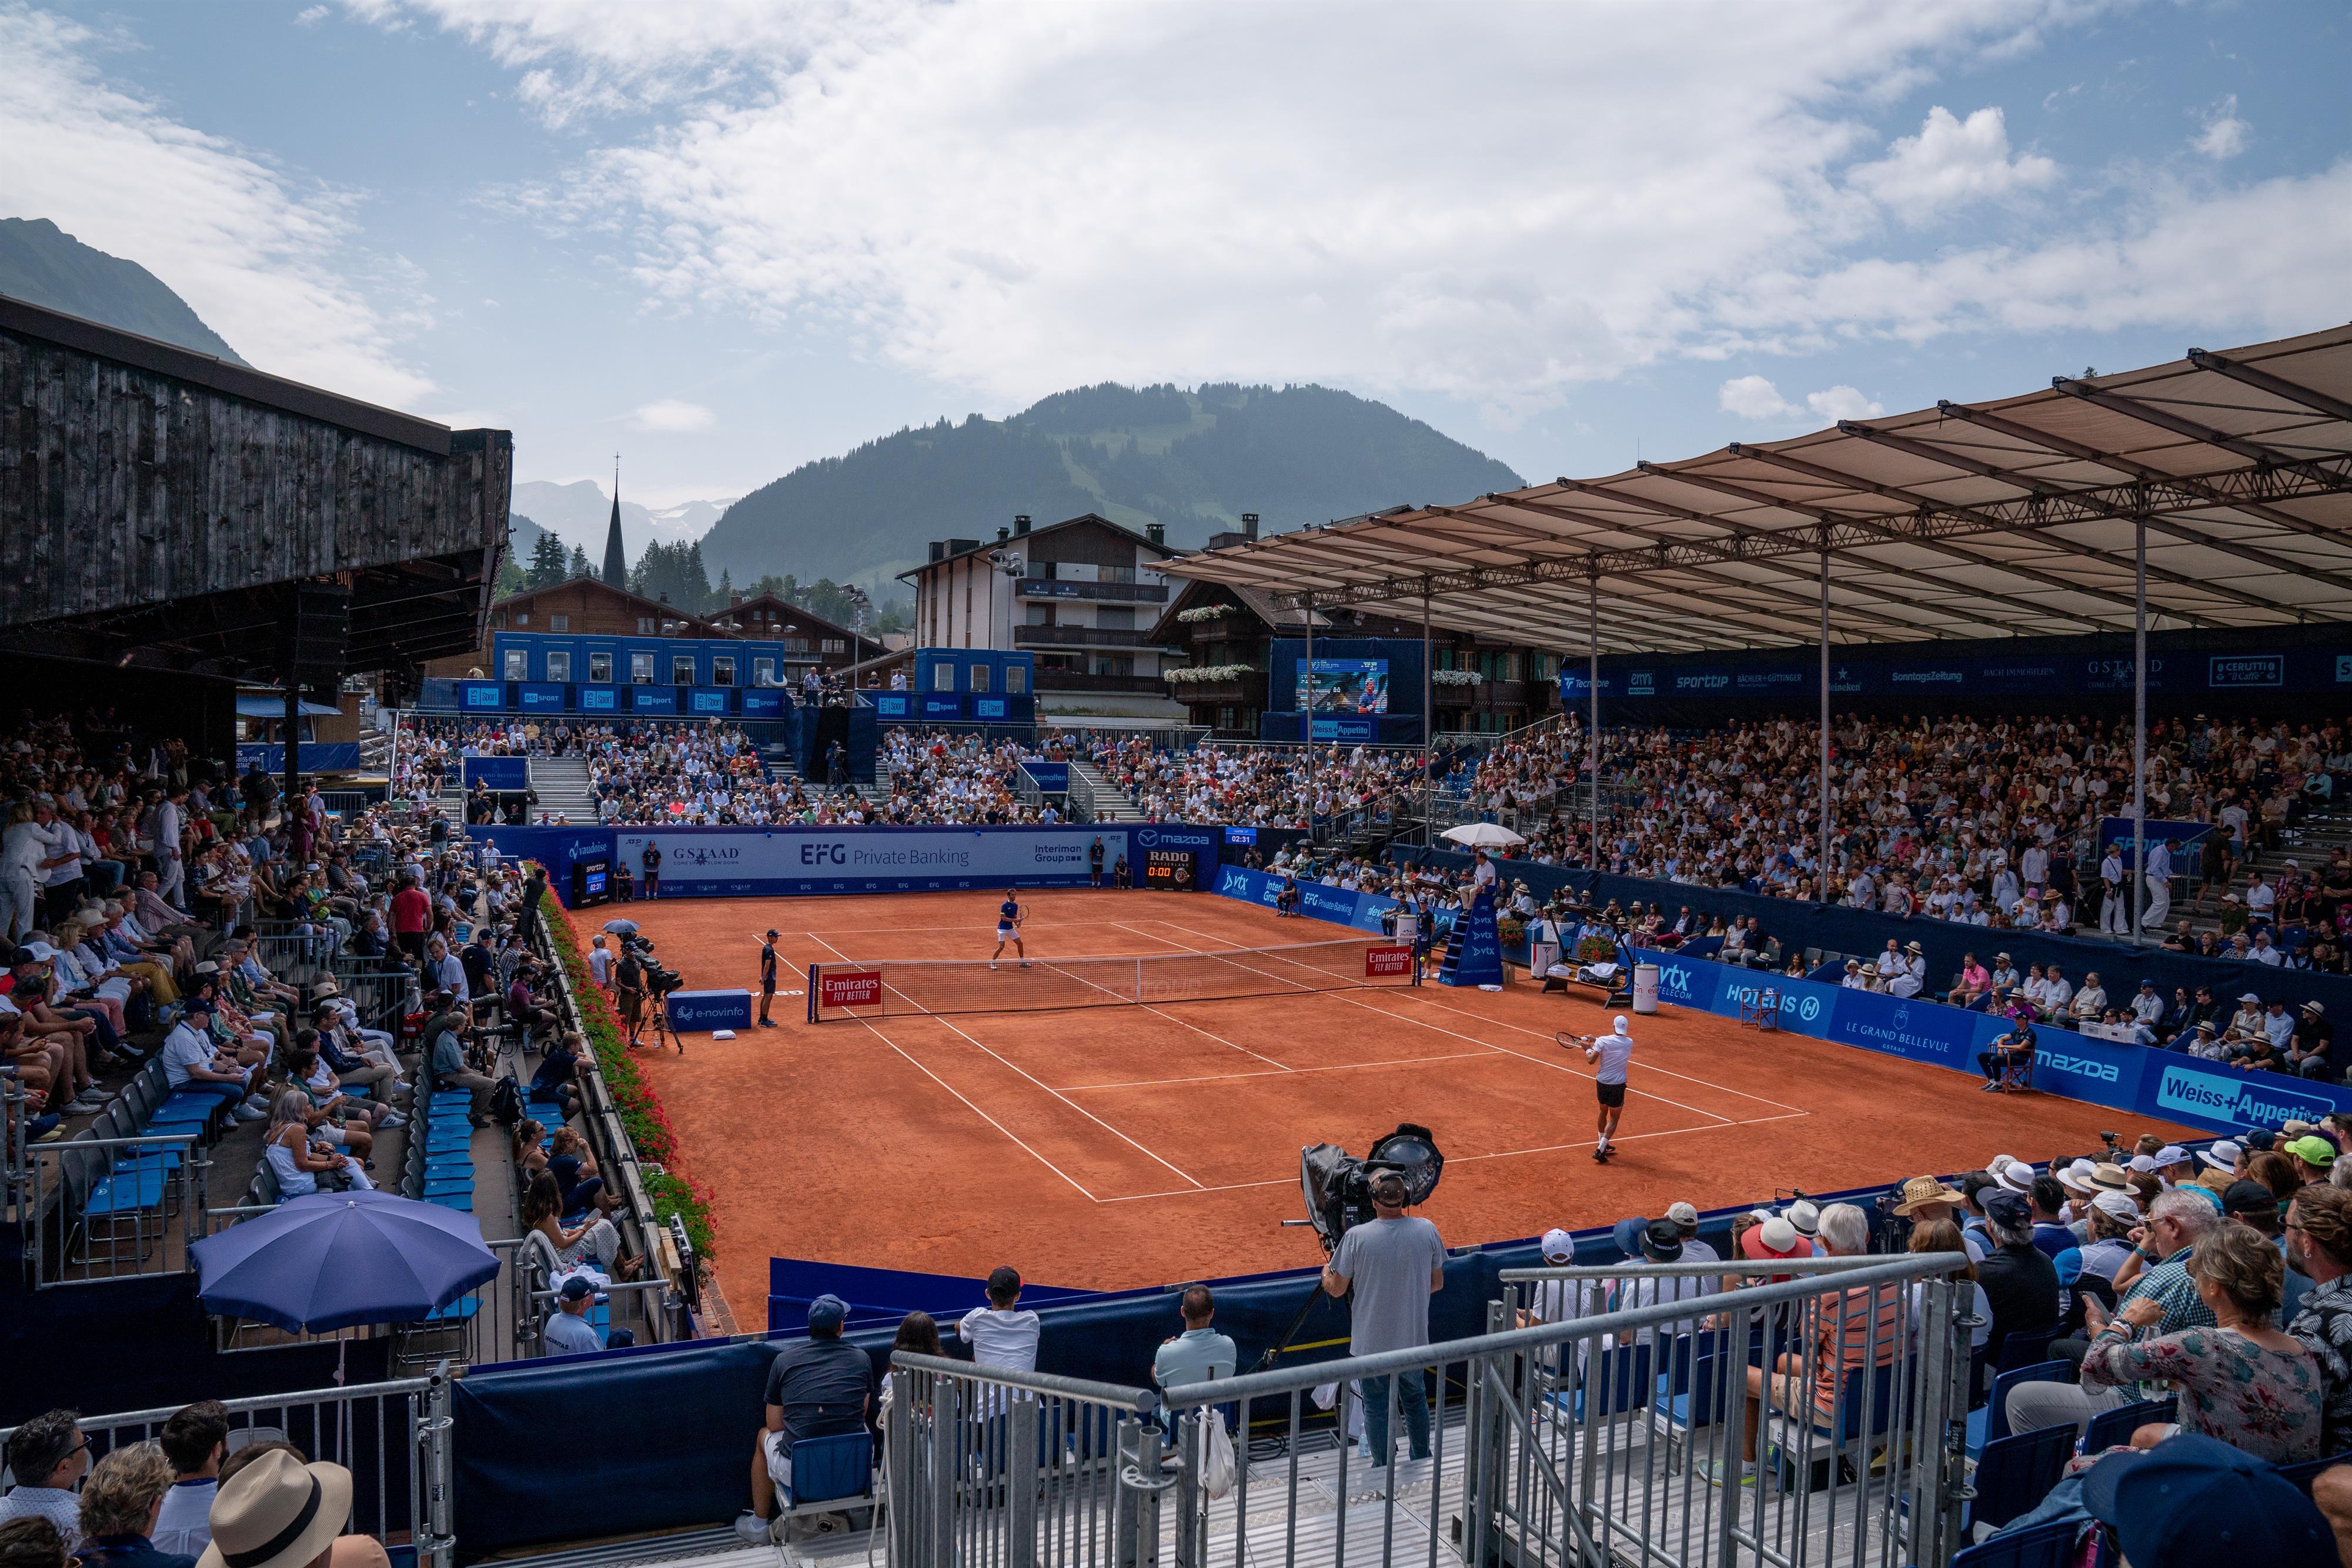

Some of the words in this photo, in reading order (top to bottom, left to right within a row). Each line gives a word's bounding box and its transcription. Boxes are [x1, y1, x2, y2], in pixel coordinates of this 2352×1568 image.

[2089, 660, 2162, 673] GSTAD
[2226, 662, 2266, 671] CERUTTI
[1892, 671, 1962, 683] SonntagsZeitung
[1576, 679, 1609, 688] Tecnbre
[482, 692, 497, 701] Sport
[597, 694, 612, 705] Sport
[890, 702, 904, 711] Sport
[579, 842, 607, 855] vaudoise
[674, 848, 739, 859] GSTAAD
[1035, 844, 1082, 853] Interiman
[801, 843, 846, 865] EFG
[854, 849, 906, 864] Private
[910, 848, 969, 867] Banking
[1035, 854, 1064, 864] Group
[1150, 851, 1189, 862] RADO
[1148, 867, 1170, 877] 0:00
[590, 883, 601, 891] 02:31
[1304, 892, 1318, 907] EFG
[1318, 898, 1334, 910] Private
[1334, 902, 1353, 916] Banking
[1482, 947, 1495, 955] vtx
[1369, 952, 1409, 963] Emirates
[1375, 963, 1384, 971] FLY
[1385, 962, 1403, 971] BETTER
[1659, 964, 1692, 991] vtx
[826, 978, 877, 991] Emirates
[834, 991, 845, 1001] FLY
[847, 990, 870, 1001] BETTER
[1658, 987, 1692, 1001] TELECOM
[696, 1007, 743, 1018] e-novinfo
[1846, 1022, 1857, 1032] LE
[1860, 1025, 1896, 1041] GRAND
[1899, 1033, 1950, 1052] BELLEVUE
[1883, 1044, 1905, 1052] GSTAAD
[1777, 1432, 1782, 1443] 5
